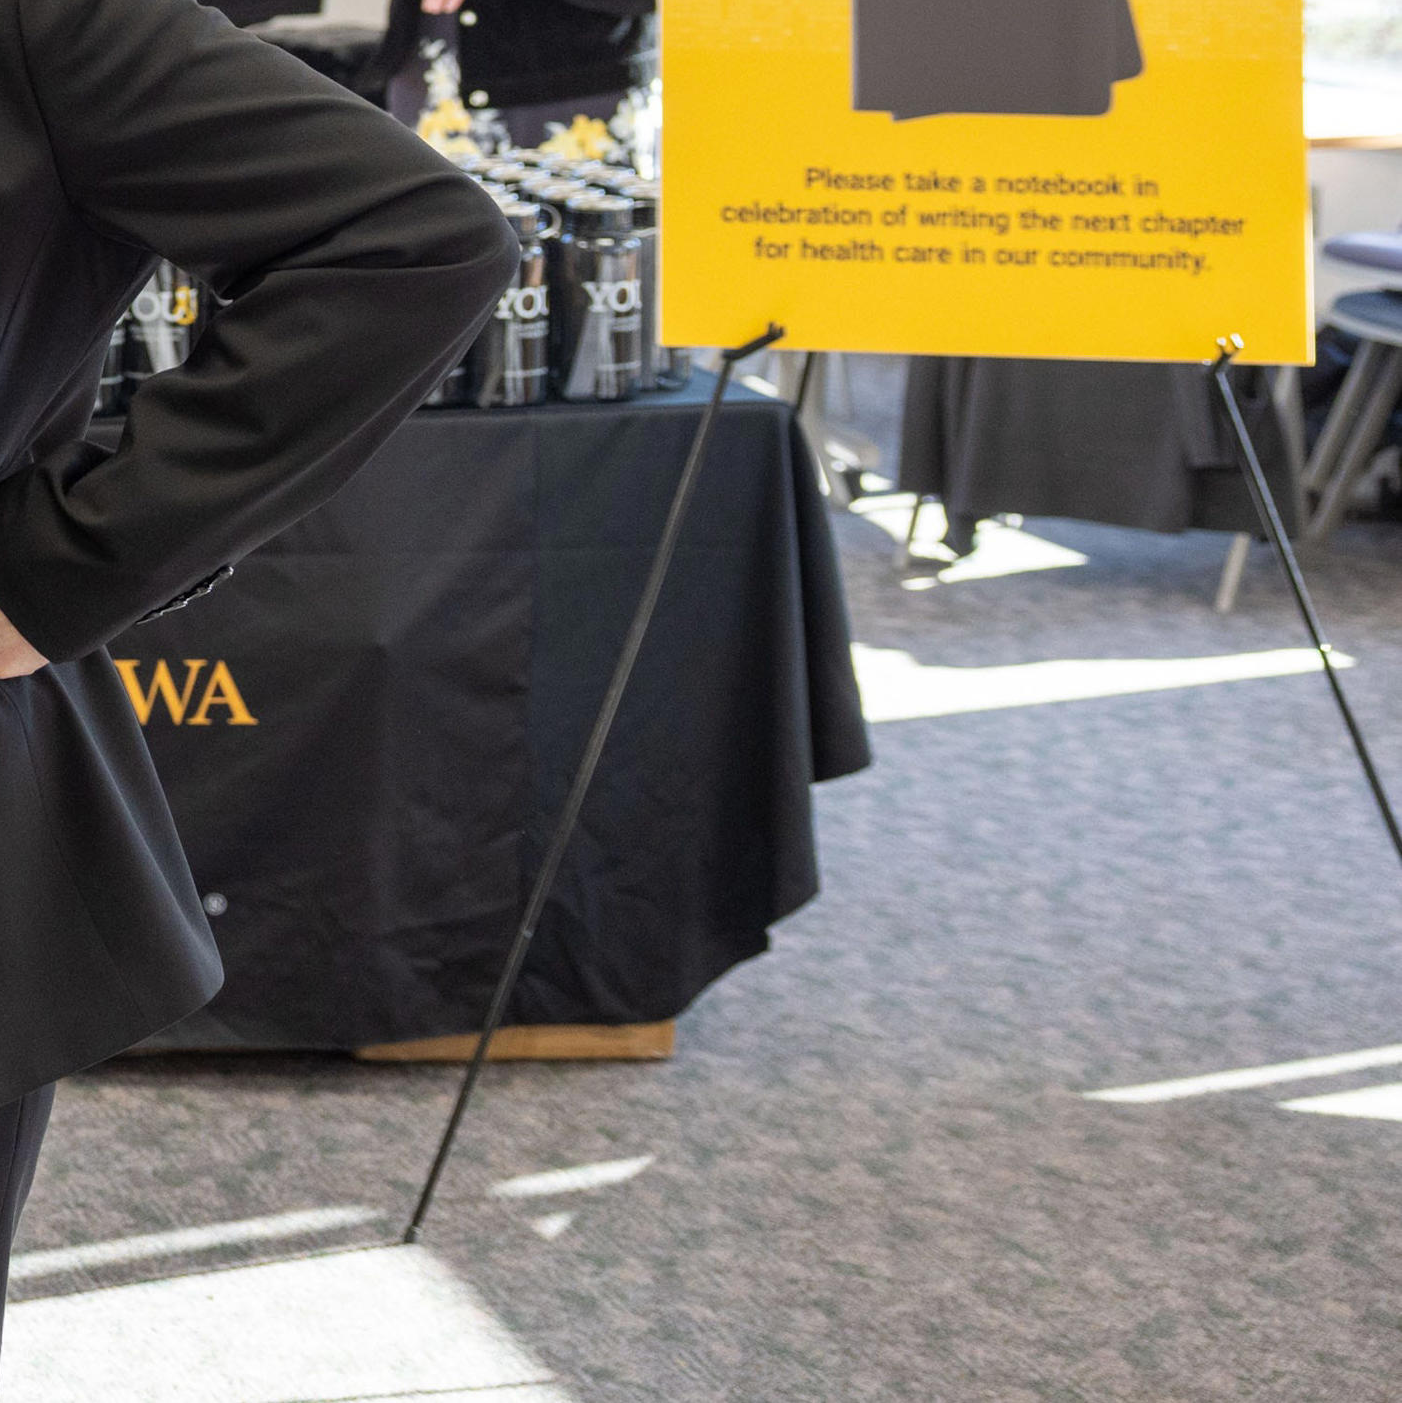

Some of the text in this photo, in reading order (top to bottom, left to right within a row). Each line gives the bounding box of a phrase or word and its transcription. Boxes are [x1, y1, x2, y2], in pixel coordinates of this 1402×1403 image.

[805, 166, 1159, 197] Please take a notebook in
[720, 201, 1245, 239] celebration of writing the next chapter
[754, 235, 1213, 276] for health care in our community.
